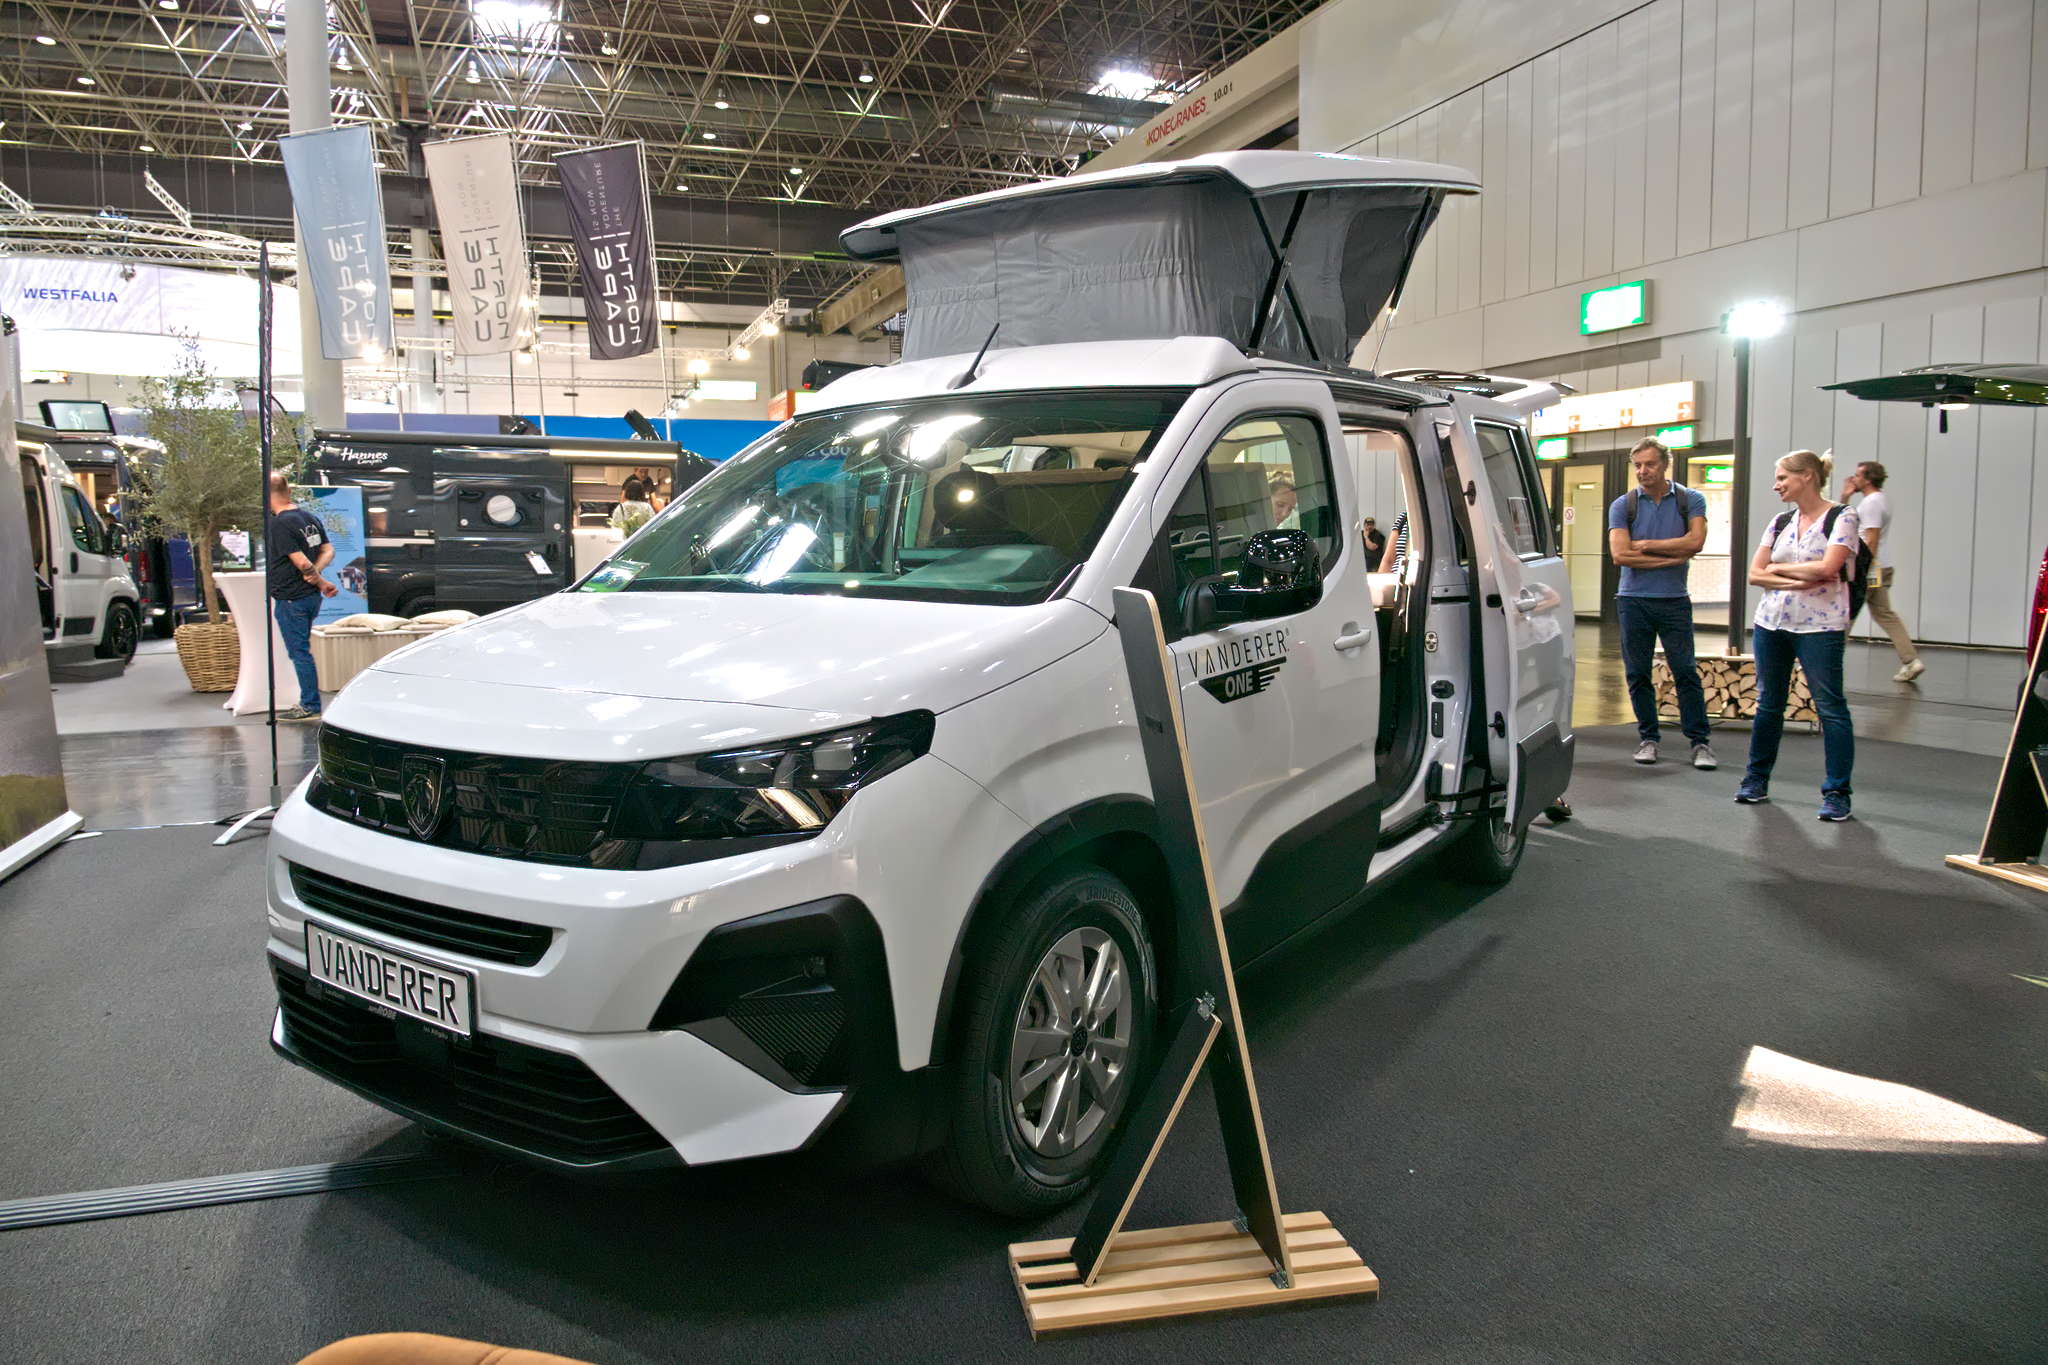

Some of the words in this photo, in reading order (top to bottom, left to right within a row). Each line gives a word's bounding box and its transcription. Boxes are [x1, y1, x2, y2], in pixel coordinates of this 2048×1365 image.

[1148, 96, 1207, 145] KONECRANES
[23, 287, 118, 303] WESTFALIA
[340, 446, 389, 461] Hannes
[1224, 670, 1254, 698] ONE
[317, 932, 460, 1025] VANDERER
